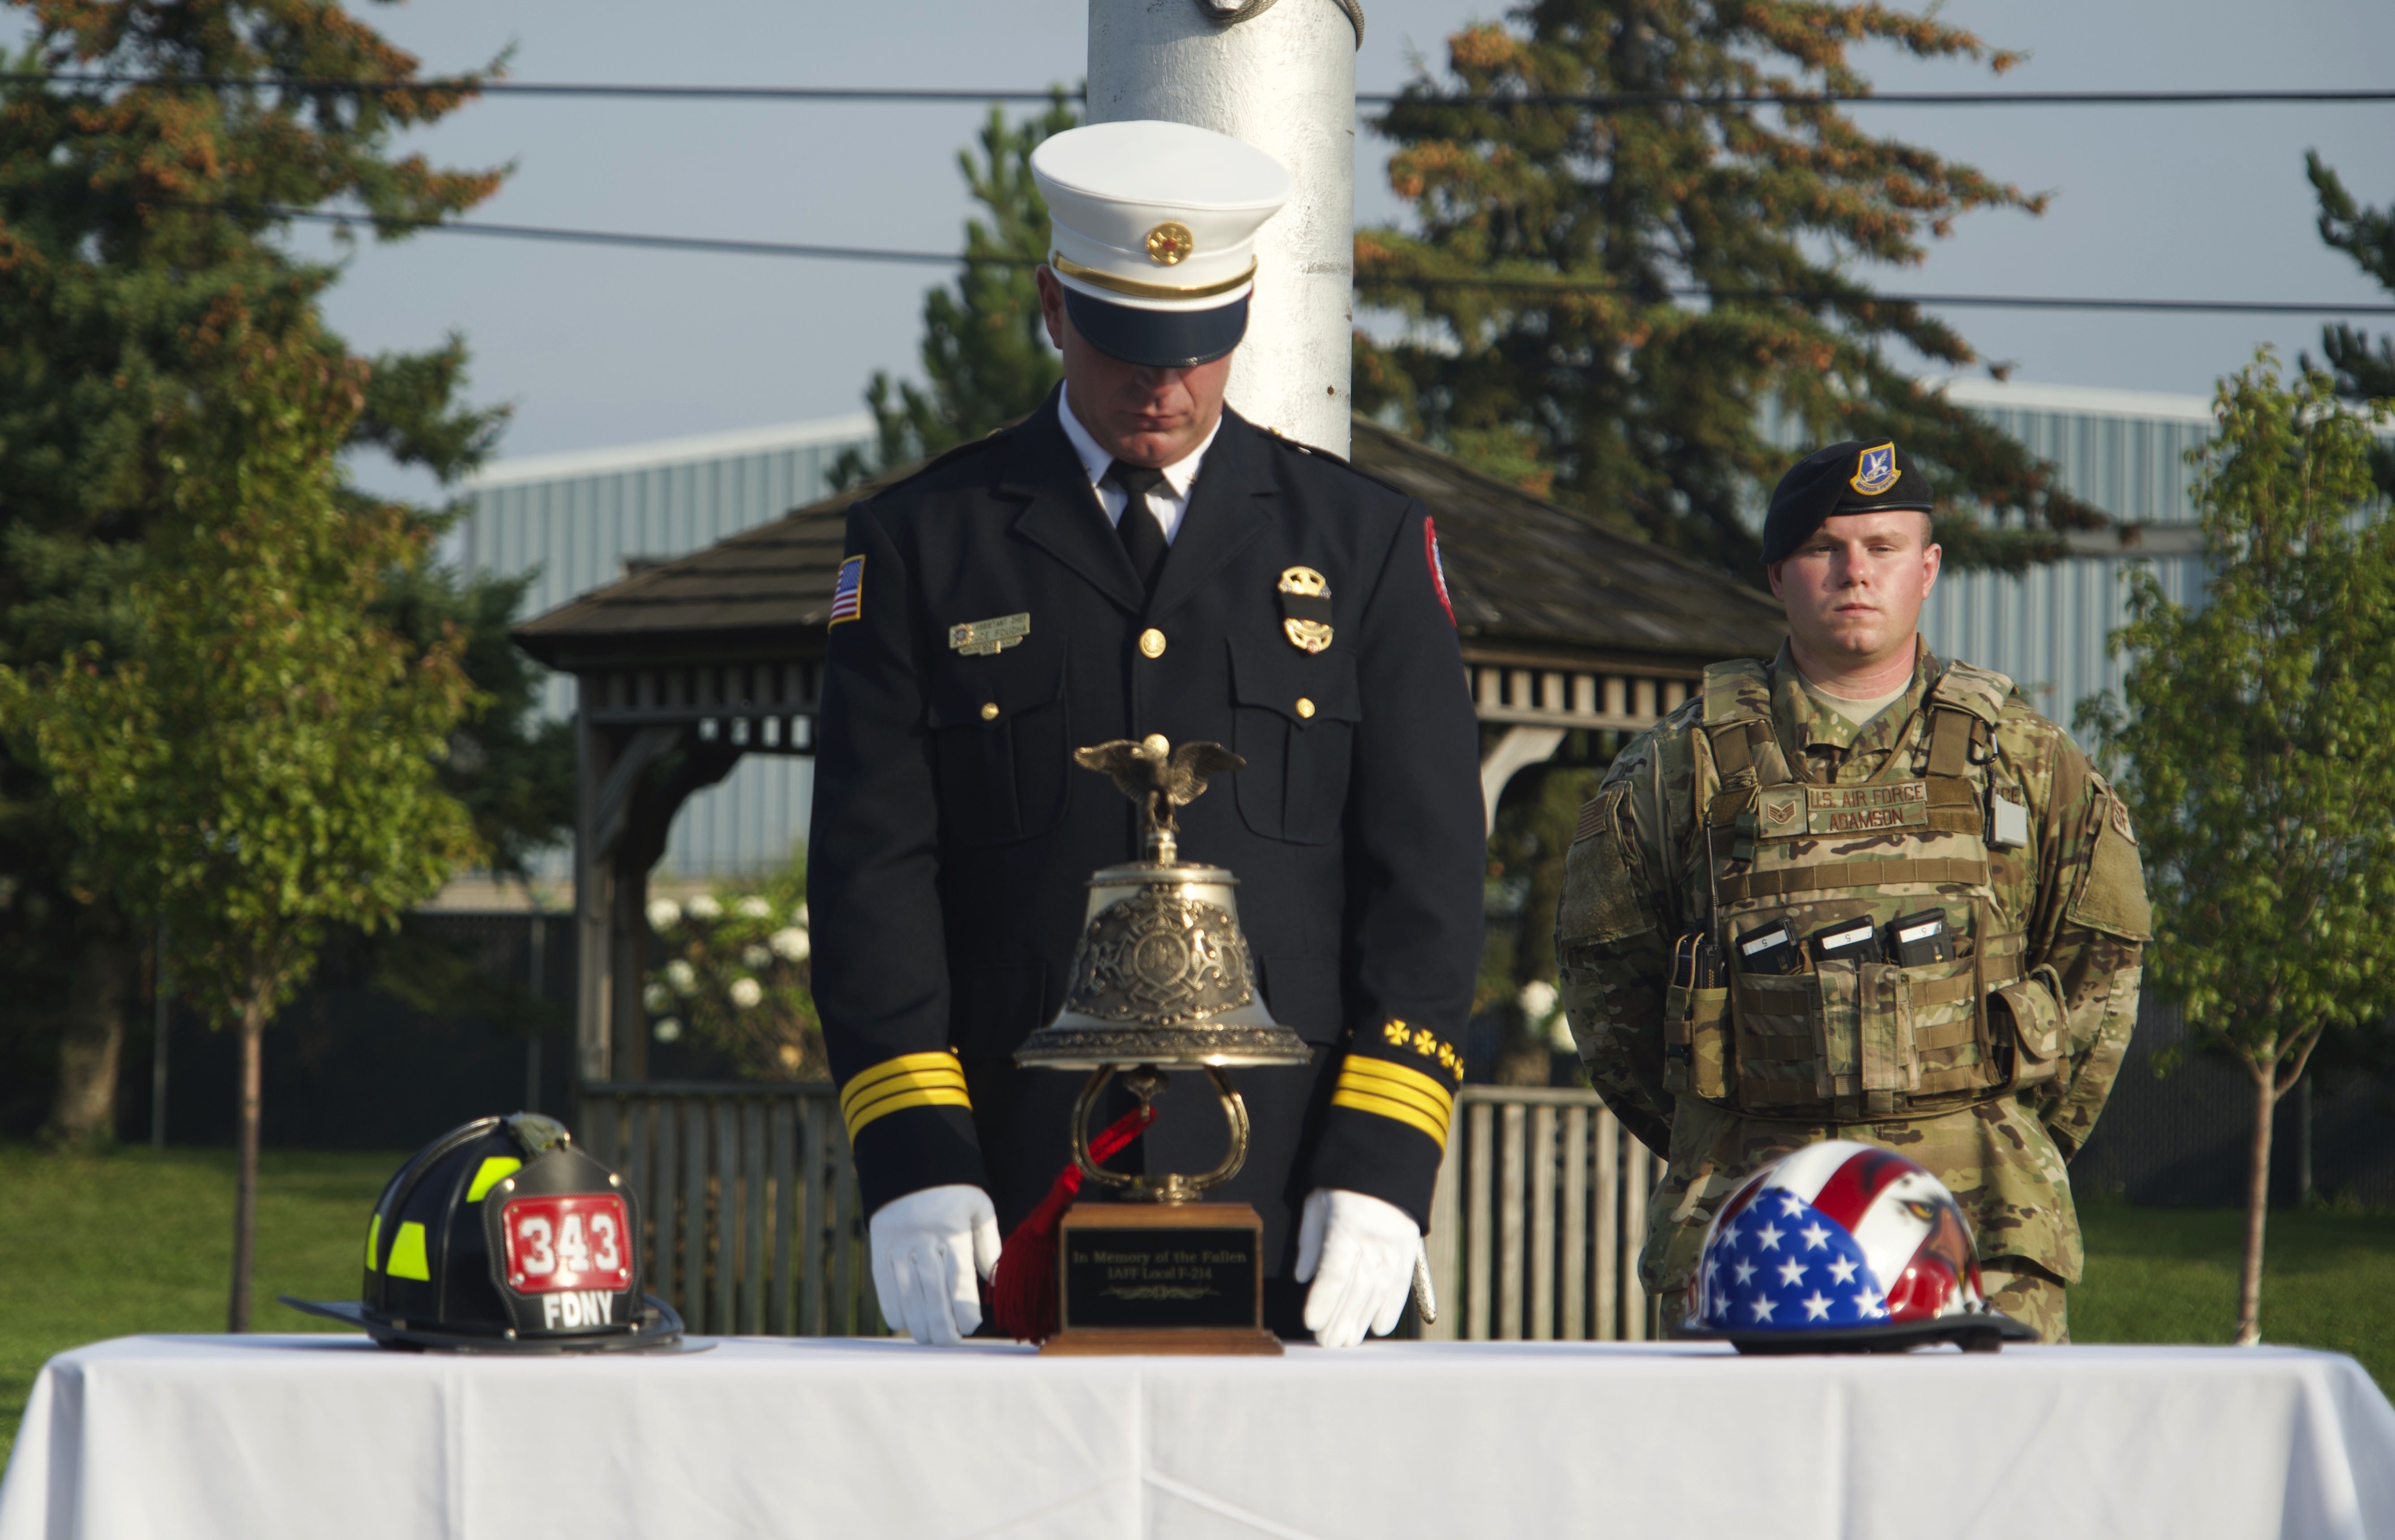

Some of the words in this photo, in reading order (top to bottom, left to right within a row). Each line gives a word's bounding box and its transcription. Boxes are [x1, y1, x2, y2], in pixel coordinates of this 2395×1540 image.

[1842, 789, 1868, 808] AIR
[1873, 785, 1924, 806] FORCE
[1830, 808, 1905, 831] ADAMSON
[518, 1213, 620, 1275] 343
[1073, 1250, 1088, 1263] In
[1093, 1250, 1150, 1266] Memory
[1155, 1250, 1169, 1263] of
[1174, 1251, 1197, 1263] the
[1202, 1250, 1247, 1263] Fallen
[1142, 1267, 1175, 1279] Local
[542, 1291, 613, 1330] FDNY
